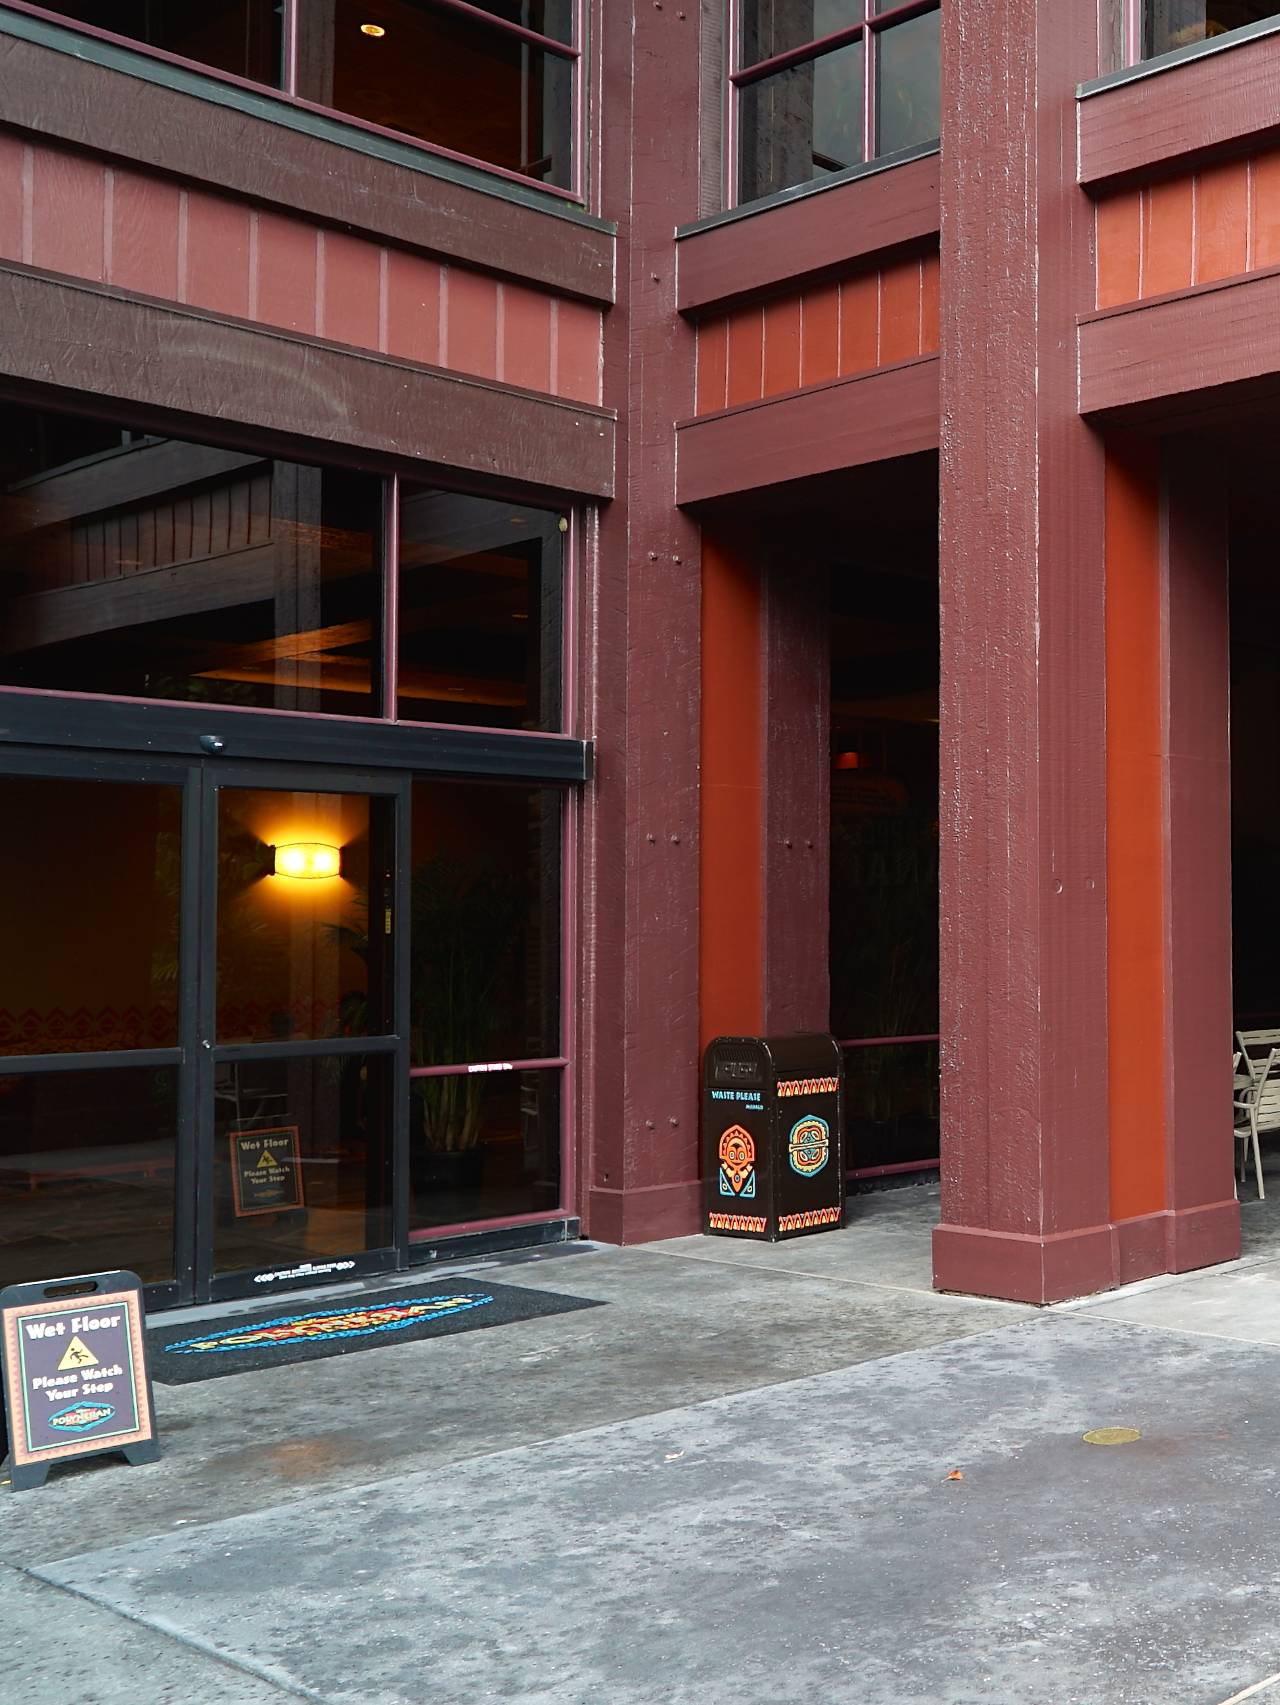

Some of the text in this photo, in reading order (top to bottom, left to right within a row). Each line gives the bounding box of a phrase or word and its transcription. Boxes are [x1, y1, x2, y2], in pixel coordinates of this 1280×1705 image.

[711, 1090, 761, 1101] WASTE PLEASE
[240, 1139, 289, 1150] Wet Floor
[26, 1315, 121, 1340] Wet Floor
[32, 1364, 123, 1390] Please Watch
[45, 1382, 114, 1401] Your Step
